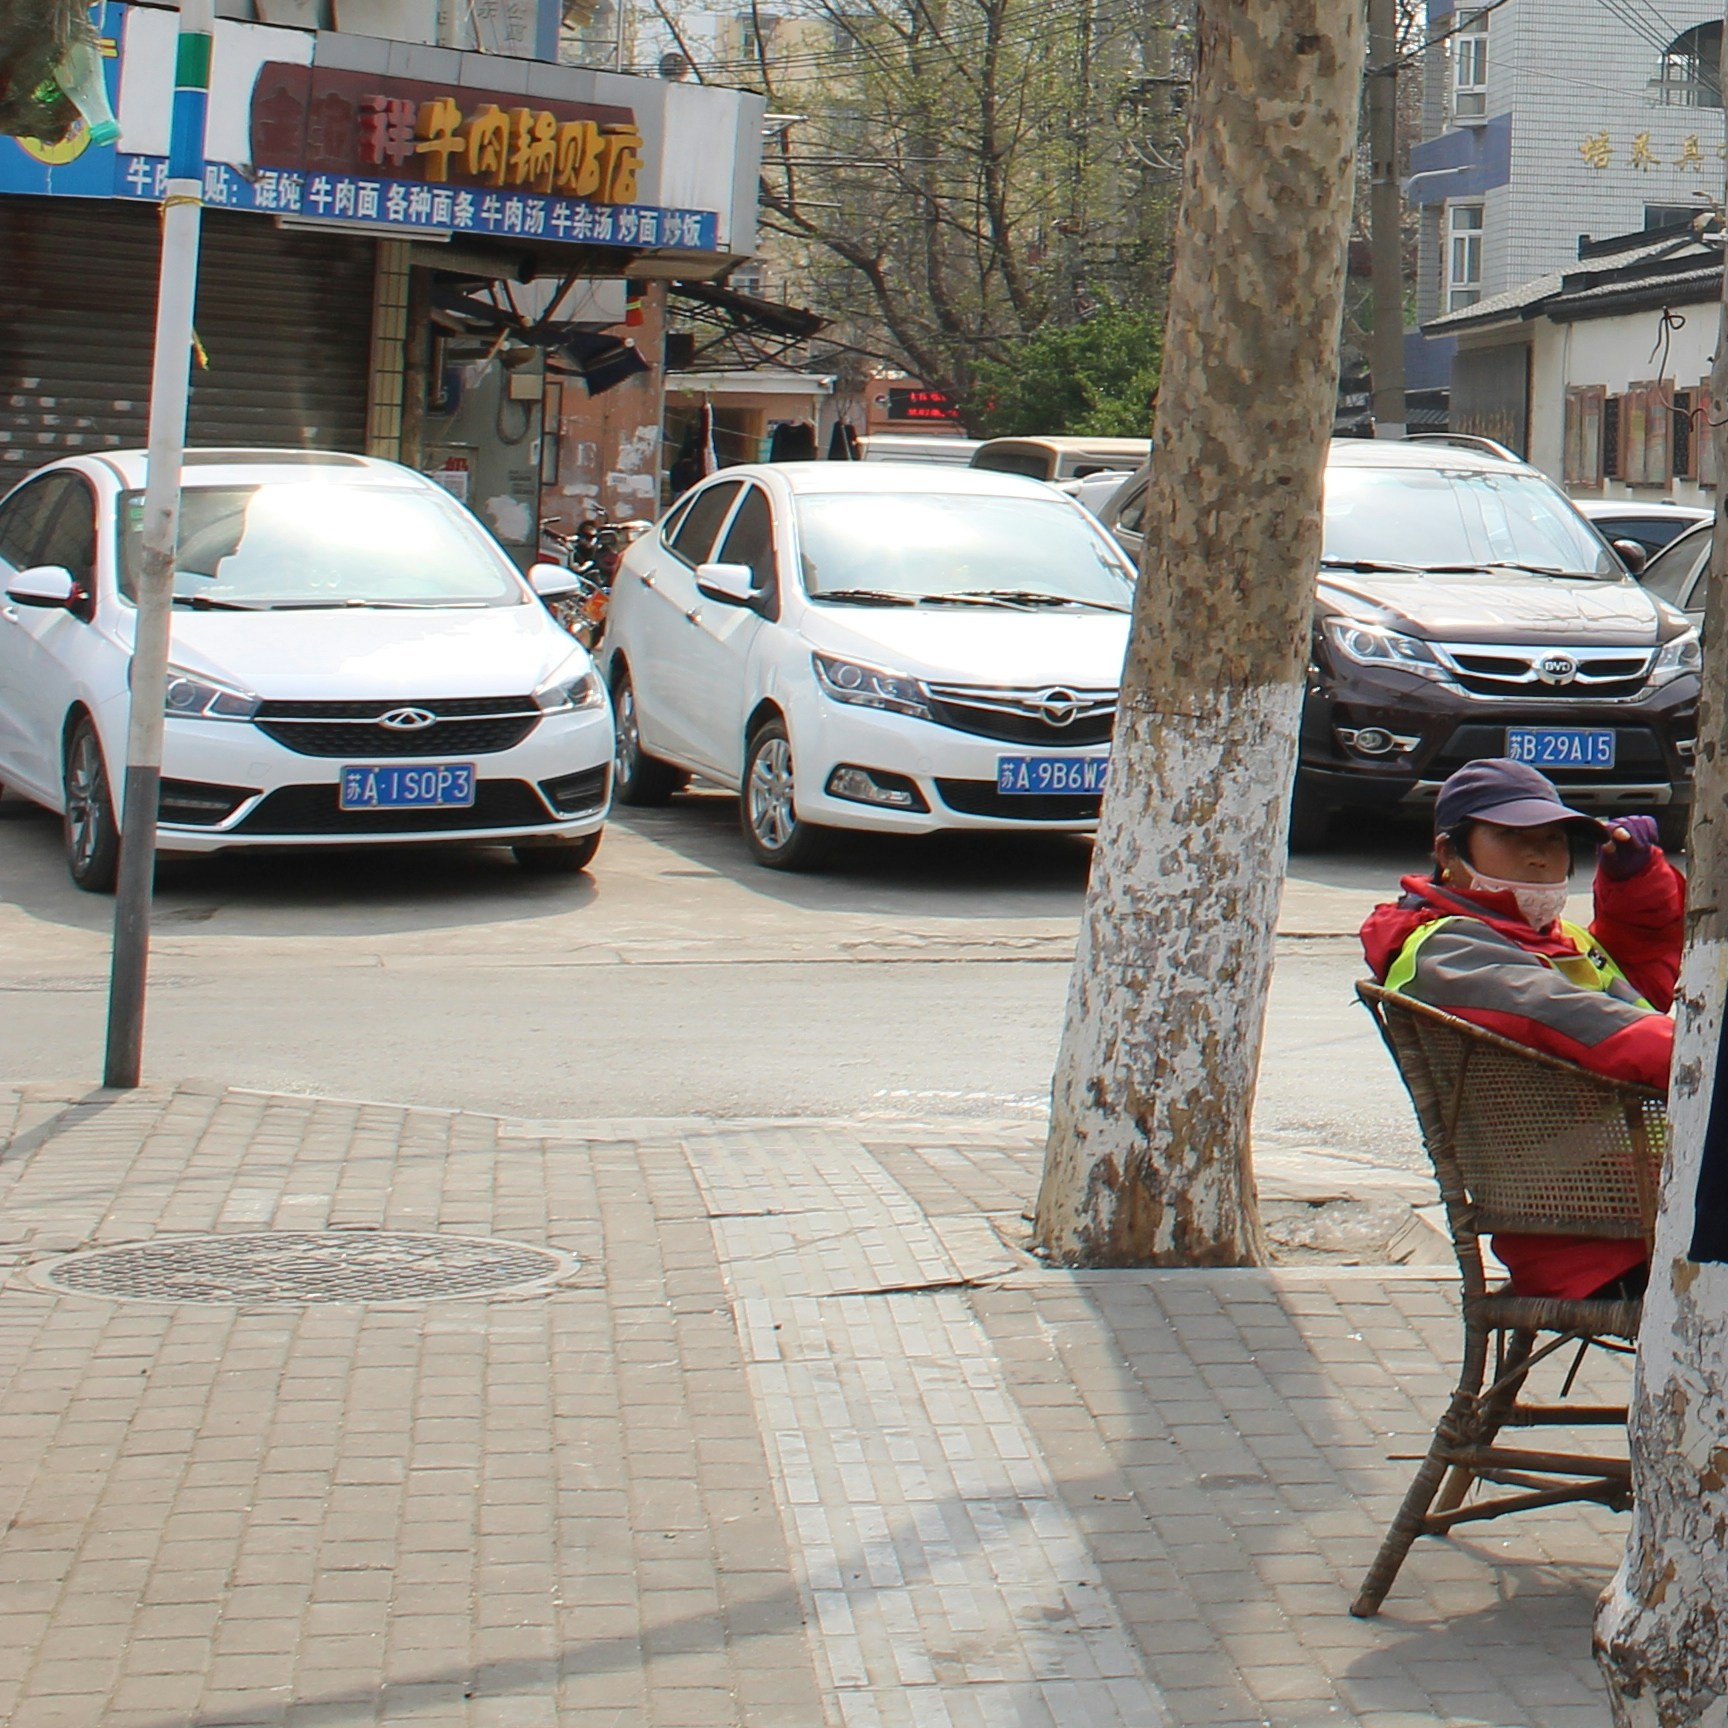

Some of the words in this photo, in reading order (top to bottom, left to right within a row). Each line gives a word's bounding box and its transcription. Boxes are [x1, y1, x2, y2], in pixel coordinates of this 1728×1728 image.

[127, 156, 239, 205] 牛肉贴：
[310, 175, 381, 220] 牛肉面
[386, 178, 475, 228] 各种面条
[481, 194, 546, 234] 牛肉汤
[551, 202, 613, 241] 牛杂汤
[618, 208, 659, 245] 炒面
[662, 212, 702, 247] 炒饭
[1544, 660, 1572, 673] BYD
